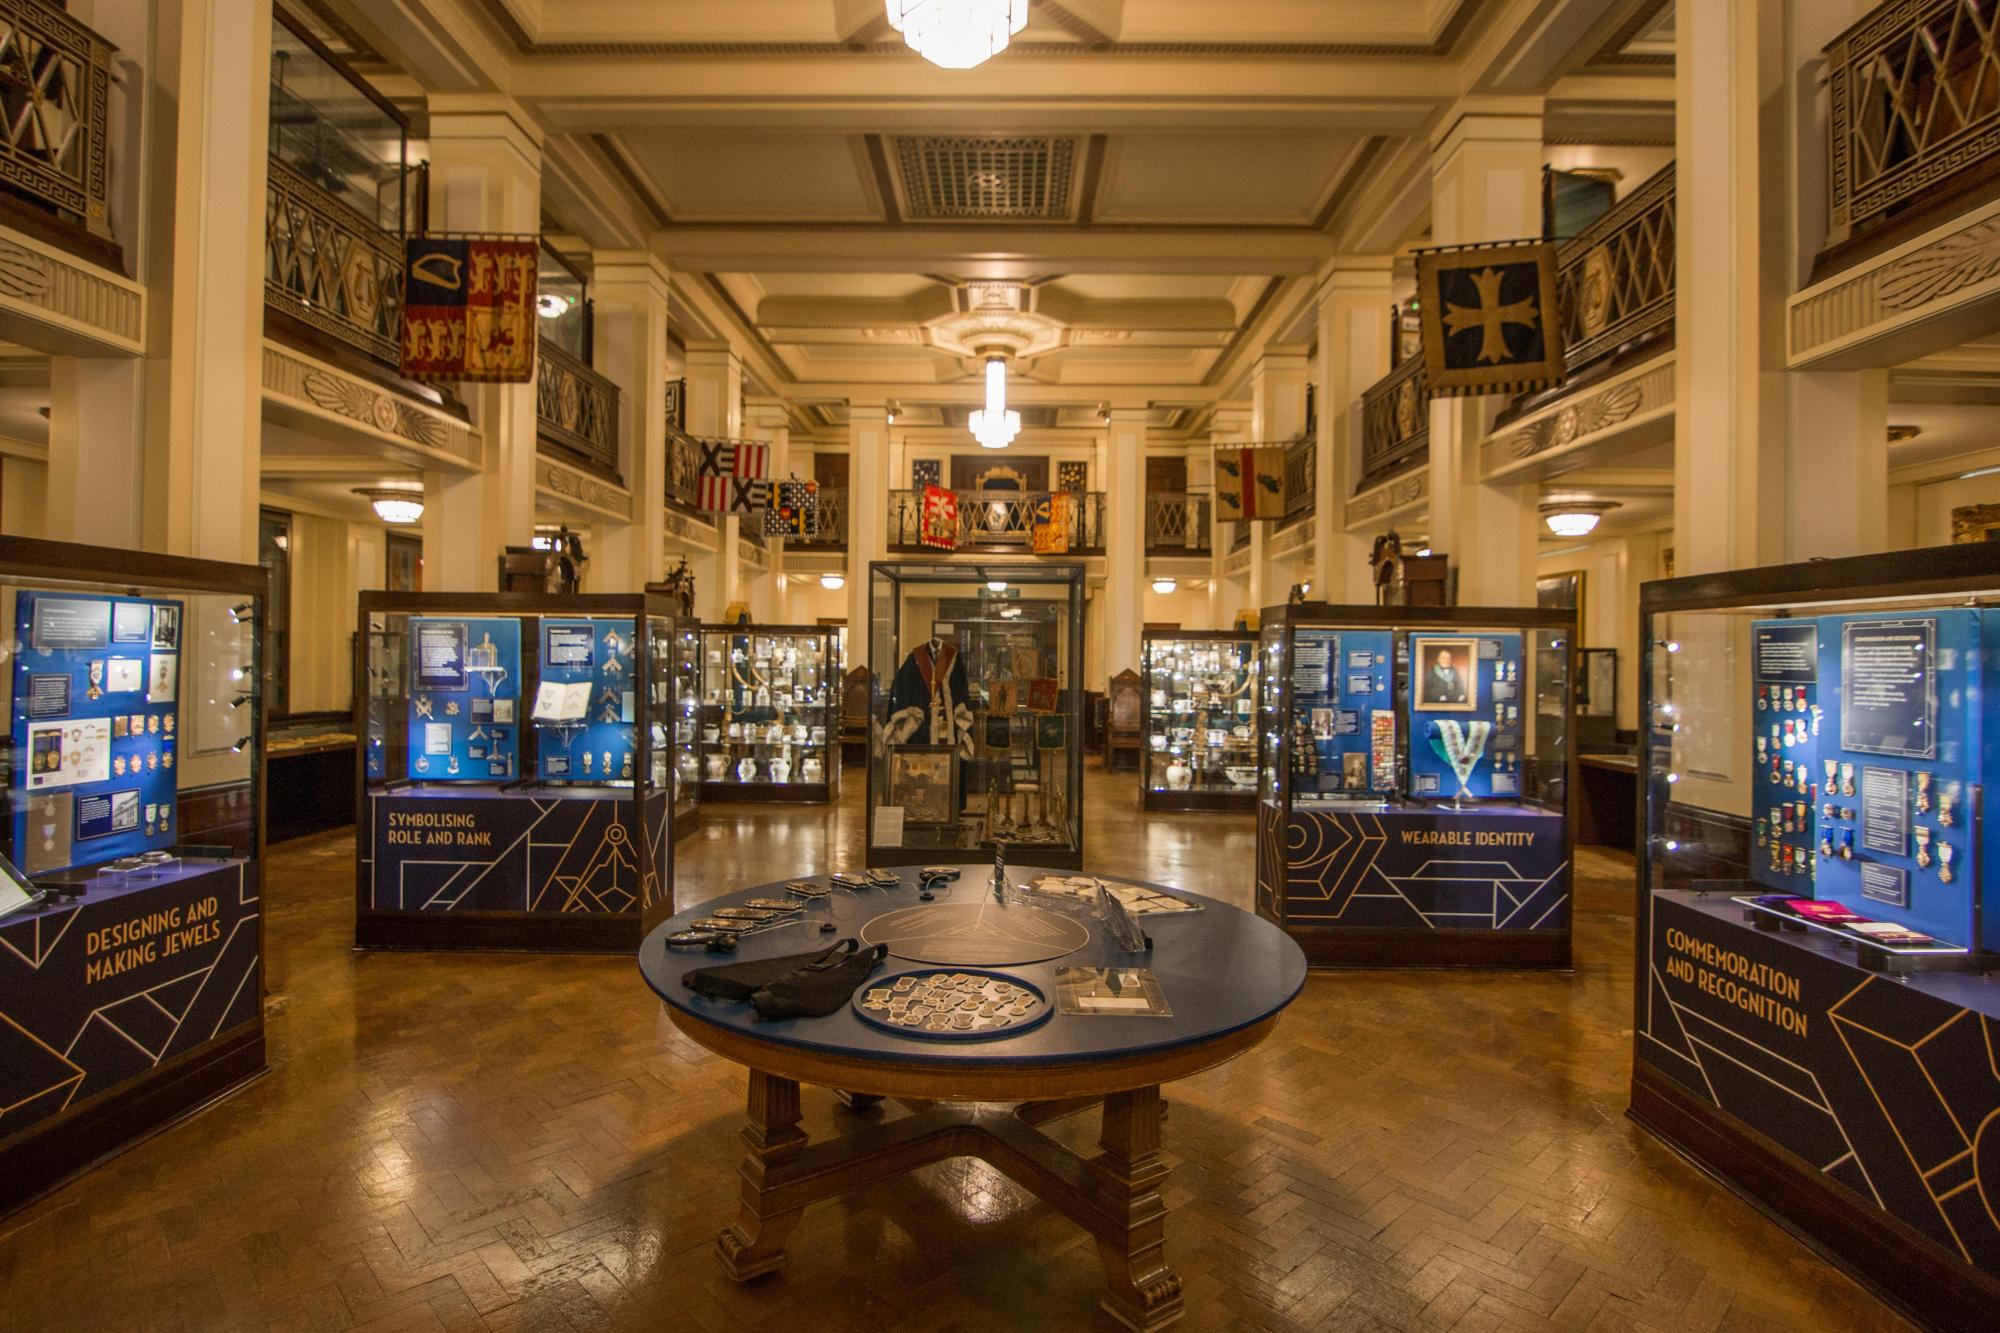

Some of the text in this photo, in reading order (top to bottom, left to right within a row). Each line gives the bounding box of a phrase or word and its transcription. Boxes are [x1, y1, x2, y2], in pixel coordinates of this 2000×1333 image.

[388, 812, 475, 828] SYMBOLISING
[388, 830, 492, 846] ROLE AND RANK
[1401, 830, 1535, 846] WEARABLE IDENTITY
[87, 896, 218, 956] DESIGNING AND
[87, 919, 220, 984] MAKING JEWELS
[1666, 927, 1800, 1002] COMMEMORATION
[1666, 956, 1808, 1039] AND RECOGNITION
